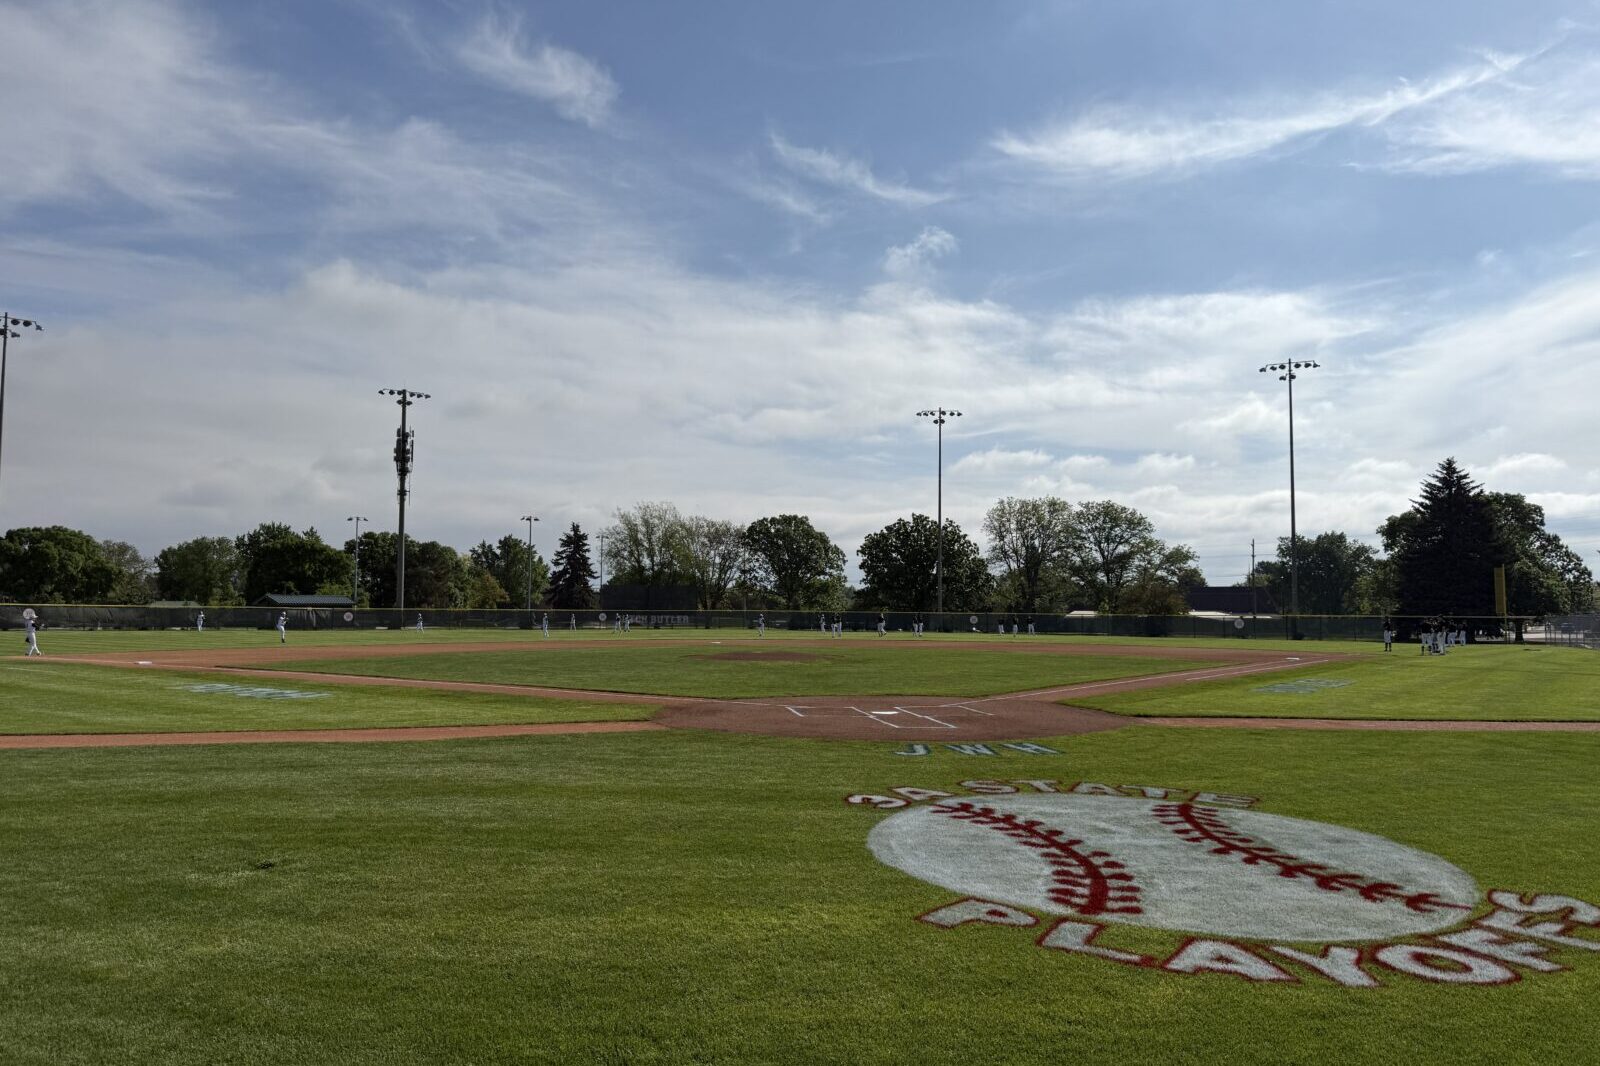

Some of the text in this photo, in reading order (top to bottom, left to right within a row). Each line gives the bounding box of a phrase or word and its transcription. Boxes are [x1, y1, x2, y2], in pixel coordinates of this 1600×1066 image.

[650, 614, 689, 624] BUTLER
[845, 778, 1260, 809] 3A STATE
[918, 889, 1600, 987] PLAYOFFS
